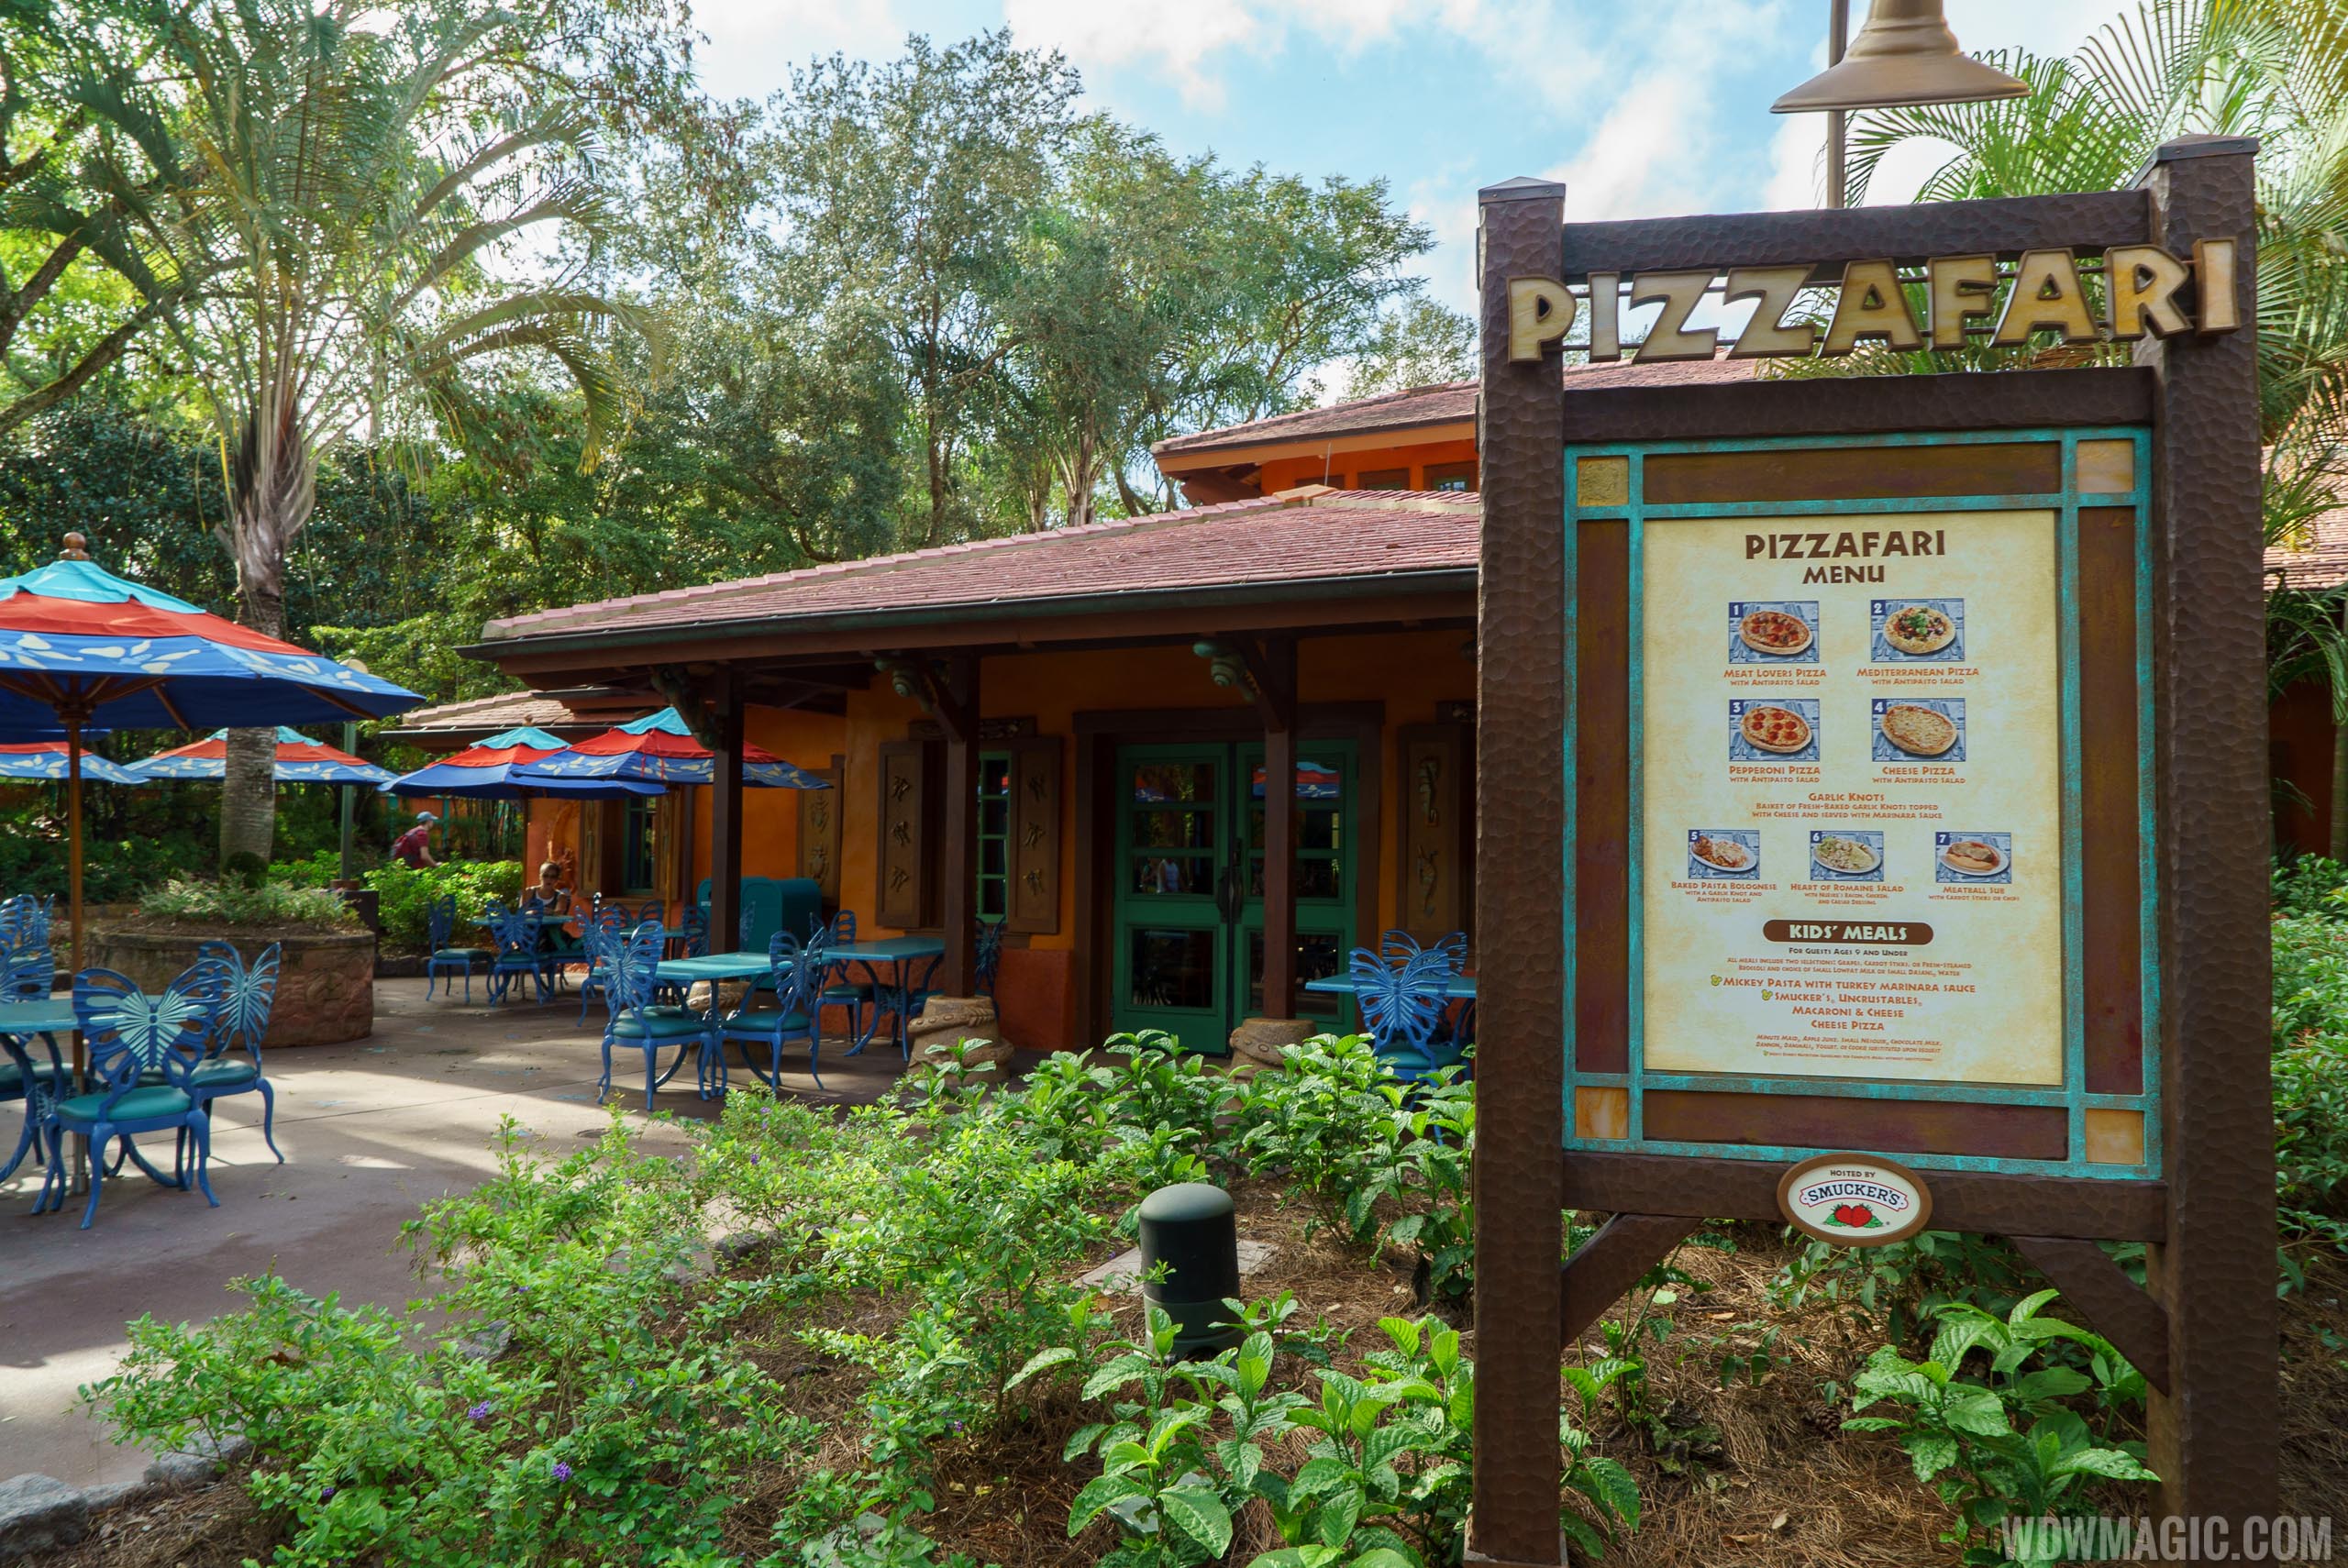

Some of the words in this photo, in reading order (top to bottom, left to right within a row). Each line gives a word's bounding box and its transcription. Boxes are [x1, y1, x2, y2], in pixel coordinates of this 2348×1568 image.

[1507, 236, 2240, 363] PIZZAFARI
[1745, 530, 1945, 559] PIZZAFARI
[1802, 565, 1885, 584] MENU
[1733, 605, 1739, 615] 1
[1874, 603, 1882, 613] 2
[1723, 668, 1754, 678] MEAT
[1756, 668, 1792, 678] LOVERS
[1796, 668, 1826, 678] PIZZA
[1856, 668, 1944, 677] MEDITERRANEAN
[1948, 668, 1979, 676] PIZZA
[1733, 702, 1741, 712] 3
[1874, 702, 1883, 712] 4
[1729, 766, 1785, 775] PEPPERONI
[1789, 766, 1821, 775] PIZZA
[1882, 766, 1919, 775] CHEESE
[1922, 766, 1955, 775] PIZZA
[1808, 792, 1844, 801] GARLIC
[1848, 793, 1885, 801] KNOTS
[1691, 832, 1697, 840] 5
[1812, 833, 1819, 842] 6
[1940, 834, 1946, 843] 7
[1730, 882, 1777, 890] BOLOGNESE
[1877, 884, 1904, 892] SALAD
[1789, 924, 1837, 939] KIDS'
[1843, 925, 1908, 941] MEALS
[1723, 977, 1764, 987] MICKEY
[1767, 978, 1801, 988] PASTA
[1804, 980, 1832, 988] WITH
[1835, 981, 1877, 990] TURKEY
[1879, 982, 1939, 991] MARINARA
[1944, 984, 1976, 993] SAUCE
[1792, 1006, 1851, 1015] MACARONI
[1855, 1008, 1864, 1016] &
[1866, 1008, 1904, 1018] CHEESE
[1811, 1020, 1847, 1029] CHEESE
[1851, 1021, 1885, 1031] PIZZA
[1830, 1169, 1862, 1177] HOSTED
[1808, 1183, 1900, 1206] SMUCKER'S
